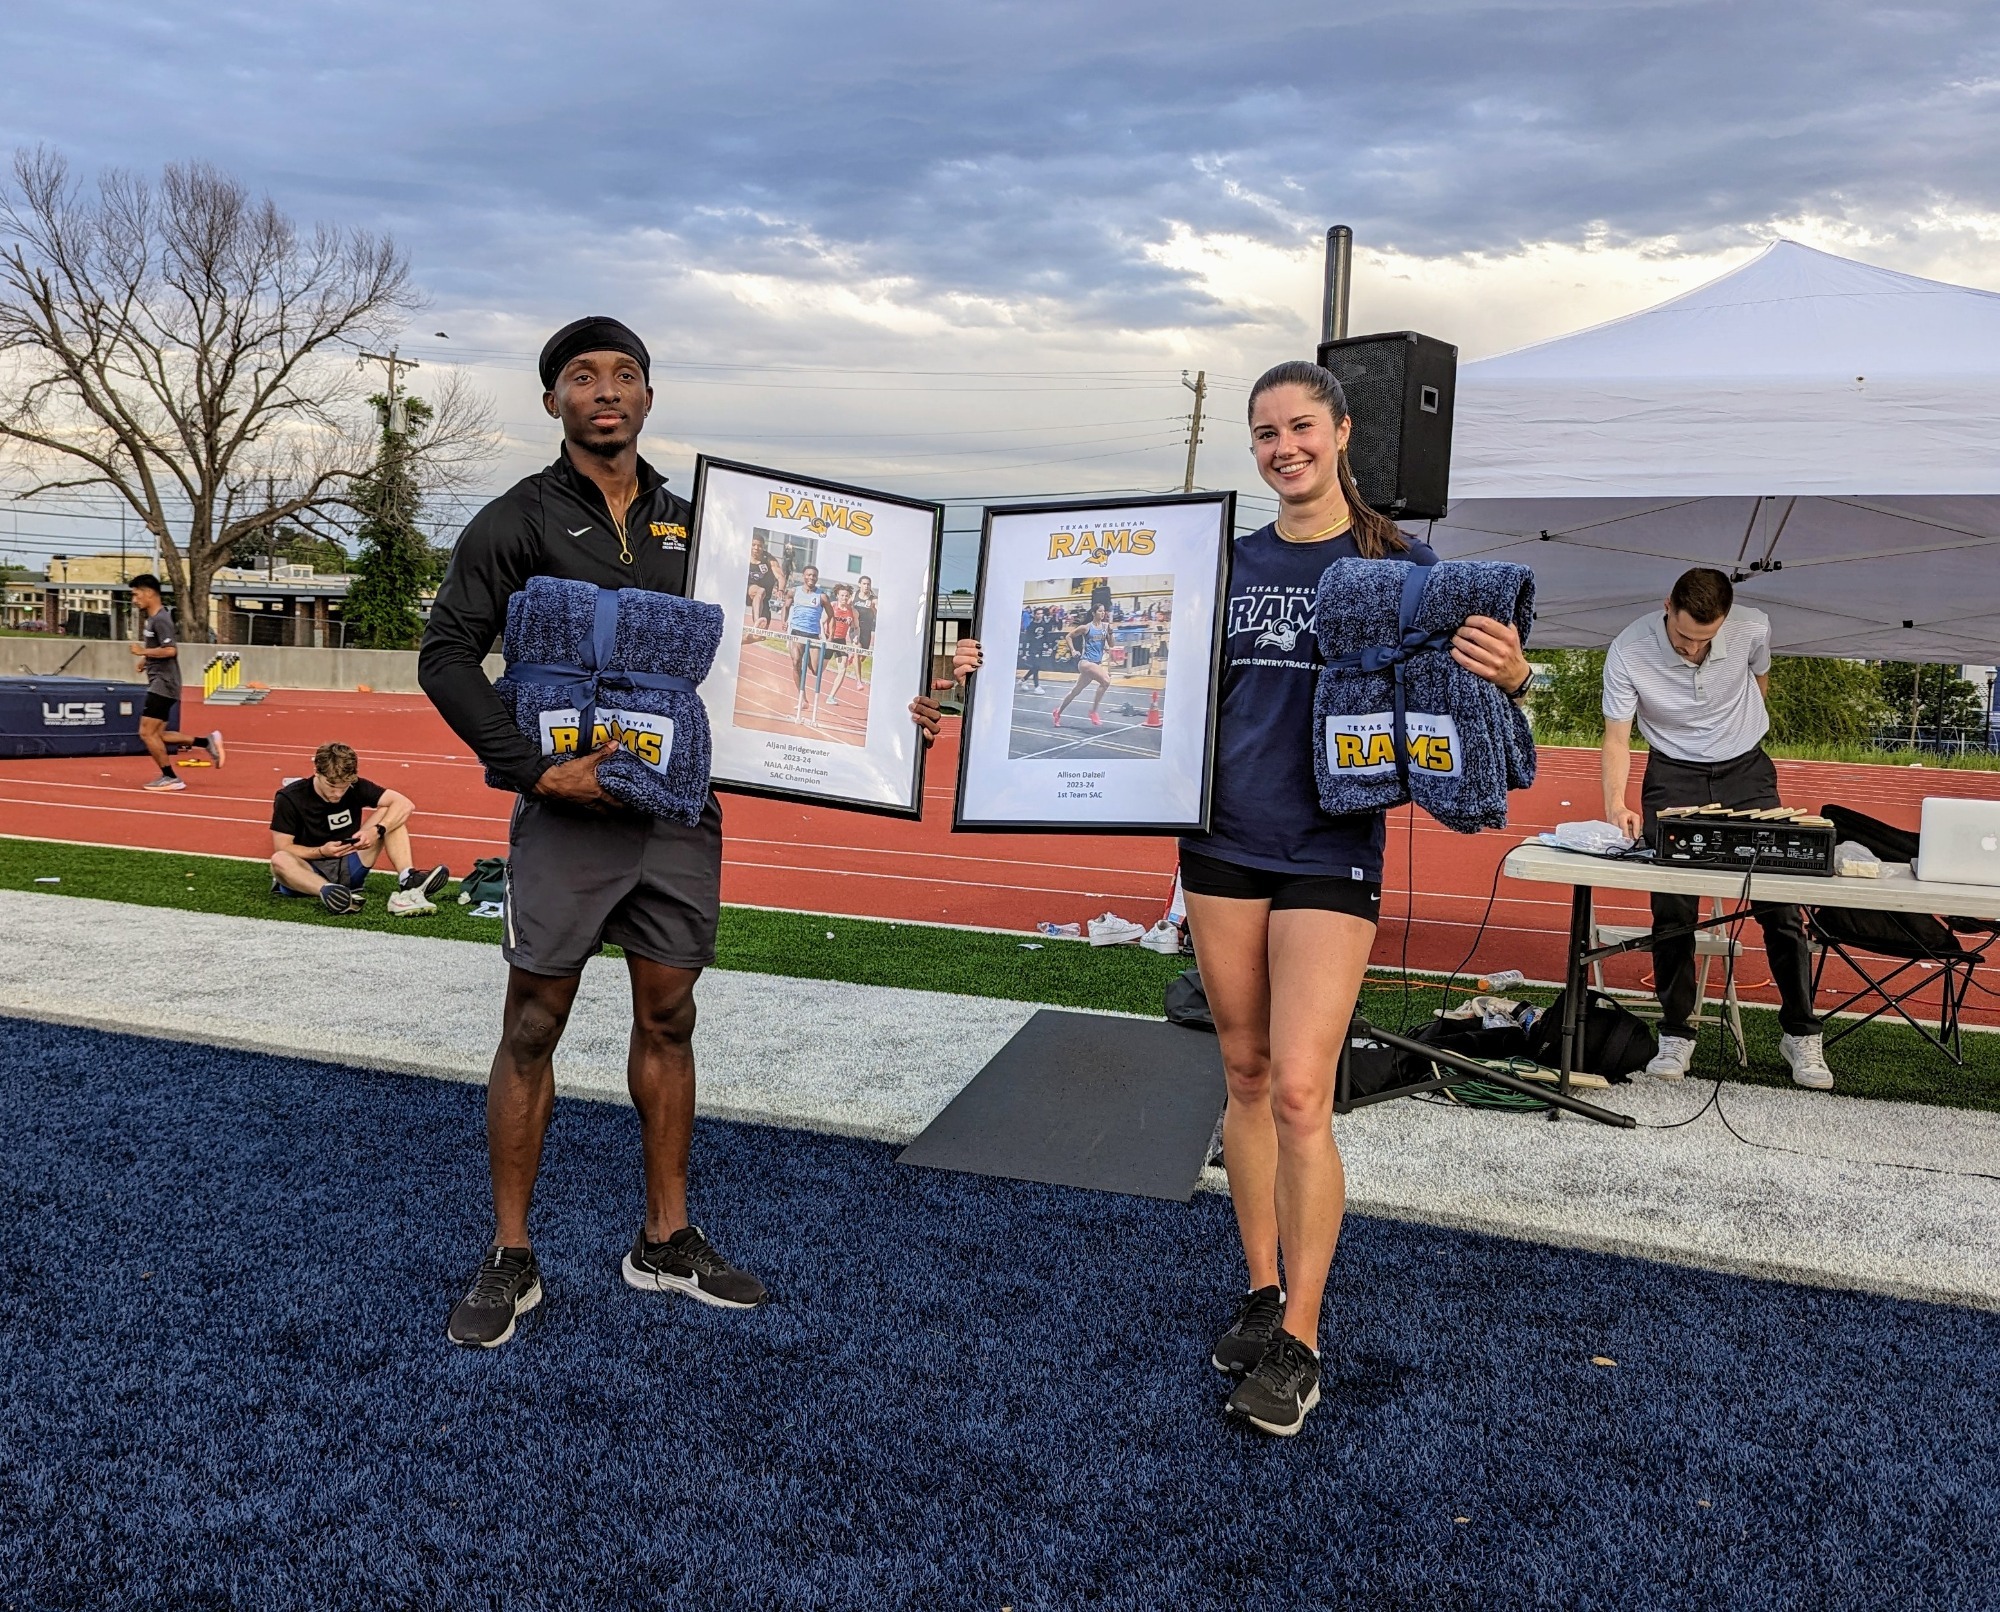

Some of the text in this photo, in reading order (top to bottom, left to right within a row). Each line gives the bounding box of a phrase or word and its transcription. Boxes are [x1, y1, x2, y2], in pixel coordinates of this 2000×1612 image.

[779, 486, 863, 508] TEXAS WESLEYAN
[766, 491, 874, 536] RAMS
[649, 523, 688, 539] RAMS
[1094, 521, 1145, 529] WESLEYAN
[1047, 529, 1157, 560] RAMS
[1245, 586, 1317, 595] TEXAS WESL
[1227, 595, 1317, 639] RAM
[743, 627, 755, 635] HOMA
[1230, 659, 1252, 667] ROSS
[42, 702, 106, 719] UCS
[1347, 724, 1382, 732] TEXAS
[788, 744, 830, 757] Bridgewater
[1335, 732, 1453, 772] RAMS
[783, 753, 812, 764] 2023-24
[764, 760, 828, 777] NAIA All-American
[770, 771, 820, 784] SAC Champion
